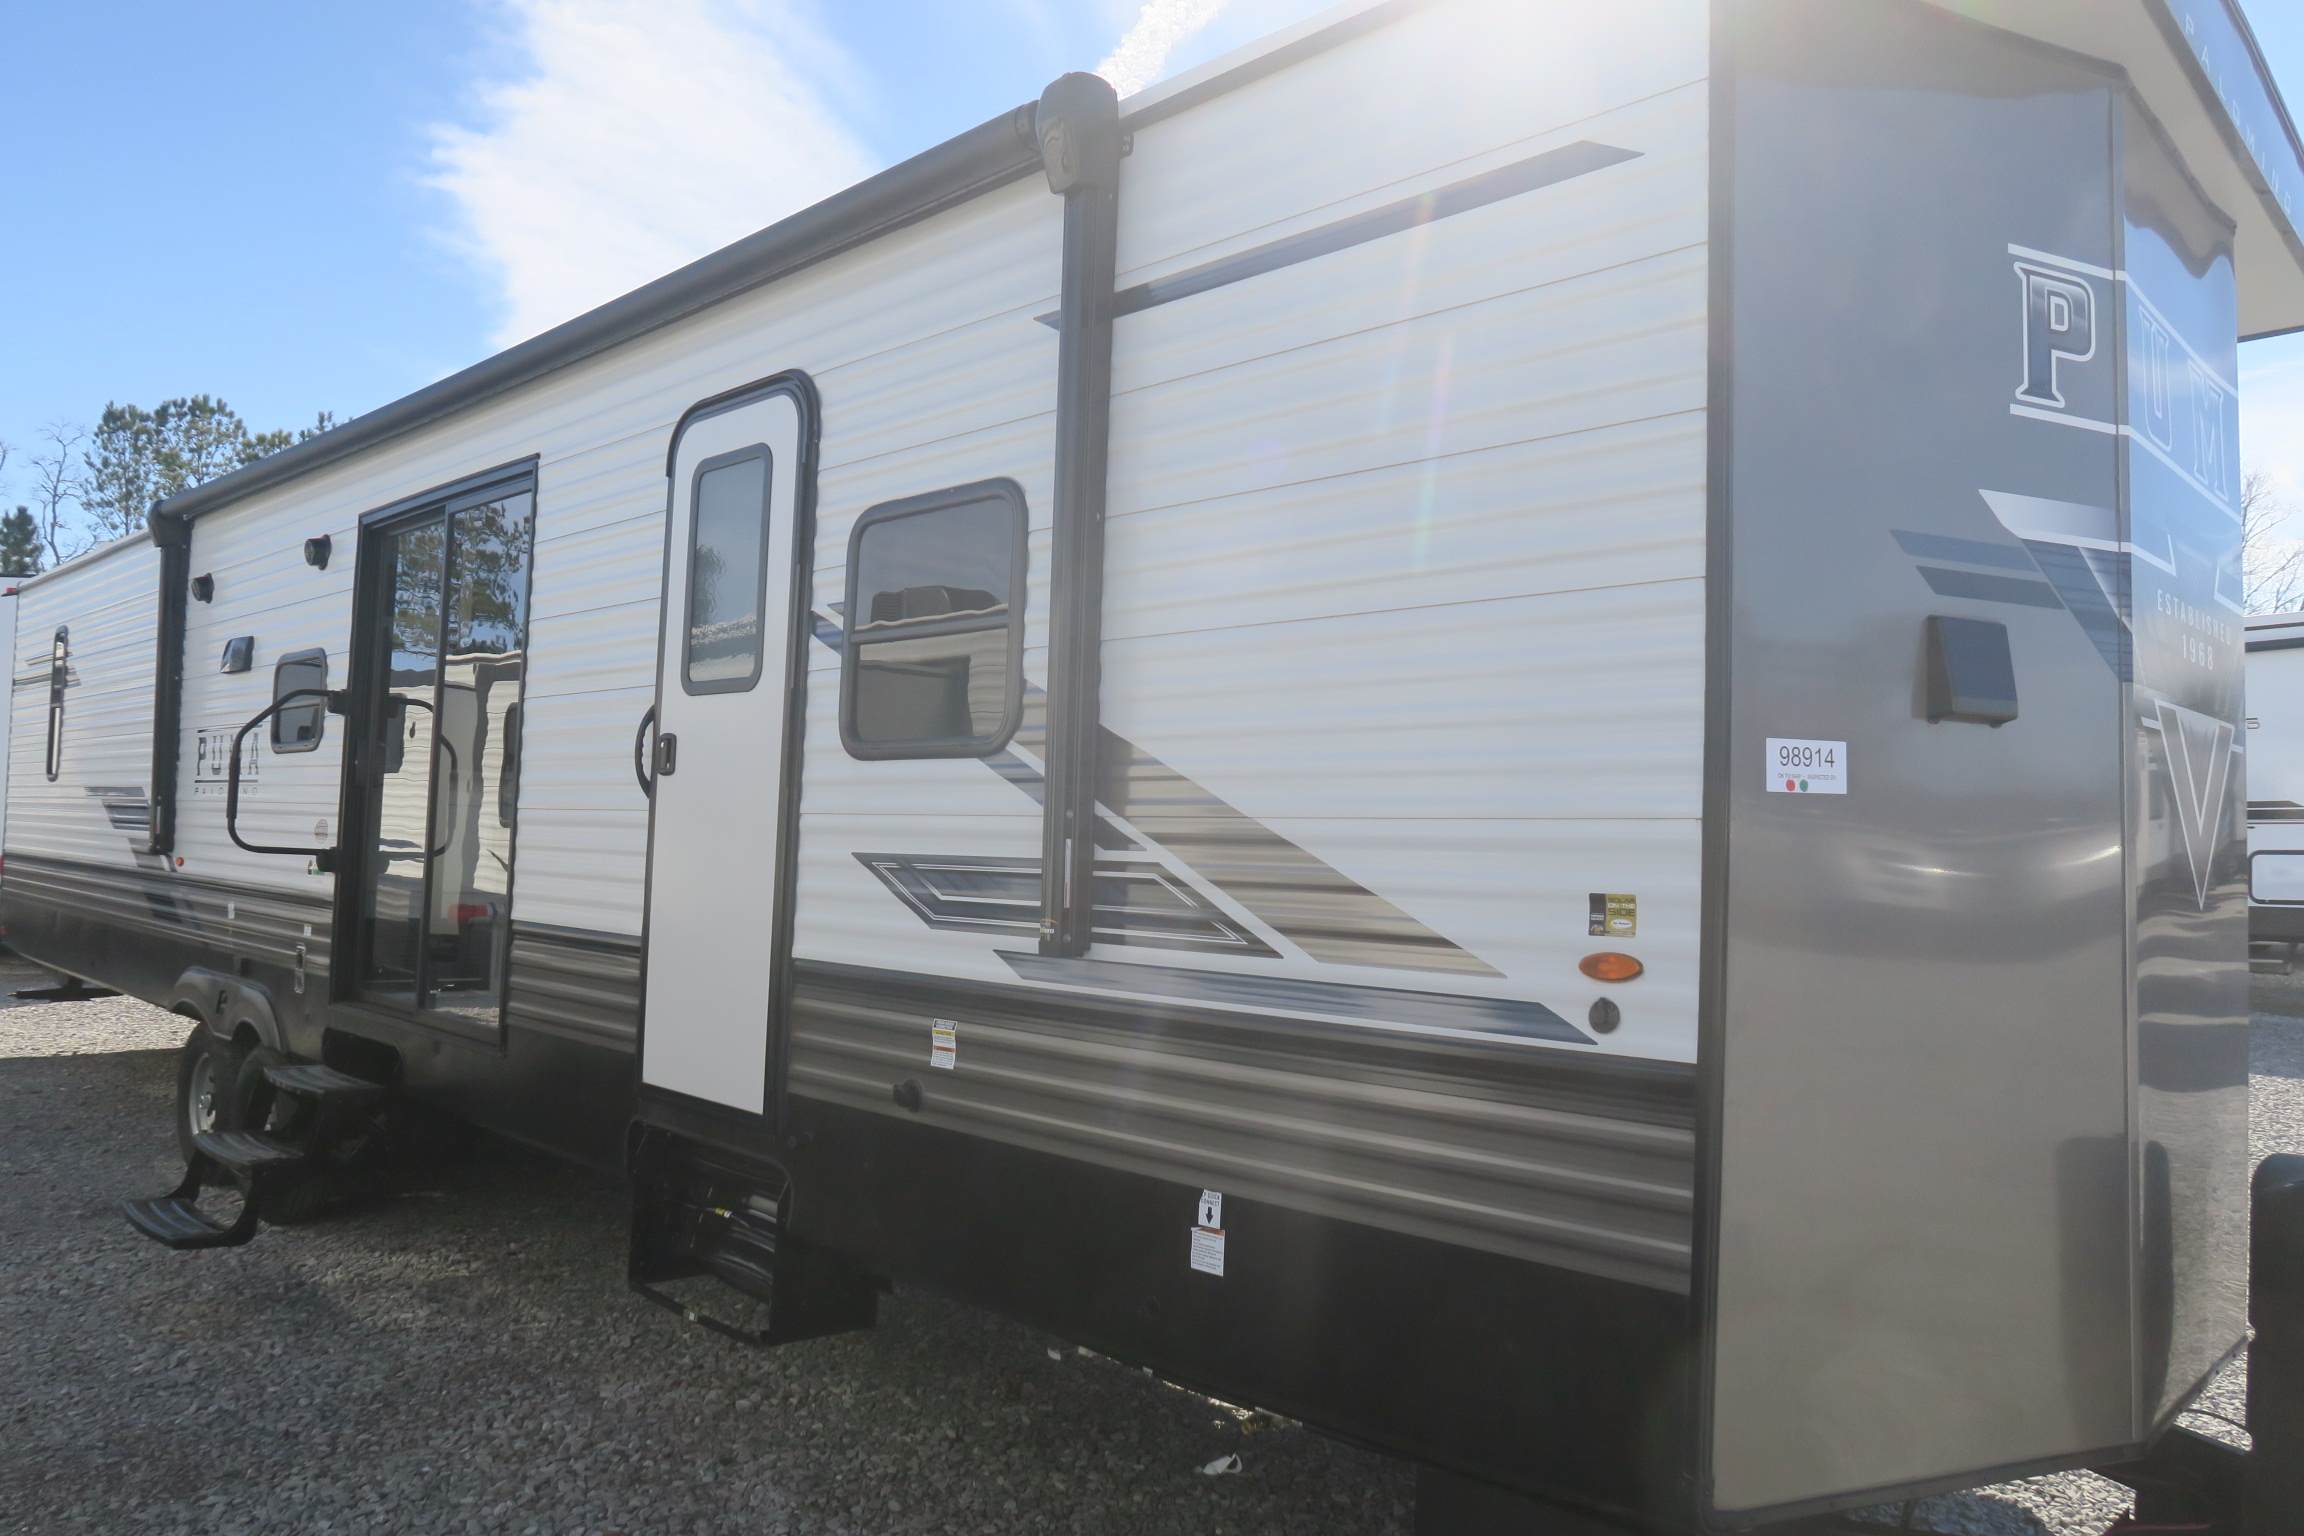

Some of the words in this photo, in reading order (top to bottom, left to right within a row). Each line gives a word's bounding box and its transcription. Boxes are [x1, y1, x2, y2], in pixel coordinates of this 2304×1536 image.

[2185, 13, 2291, 215] PALOMINO
[2157, 589, 2232, 646] ESTABLISHED
[2182, 634, 2213, 671] 1968
[196, 732, 260, 776] PUA
[1779, 745, 1835, 768] 98914
[1608, 908, 1636, 916] SIDE
[1200, 1197, 1220, 1208] CONNECT
